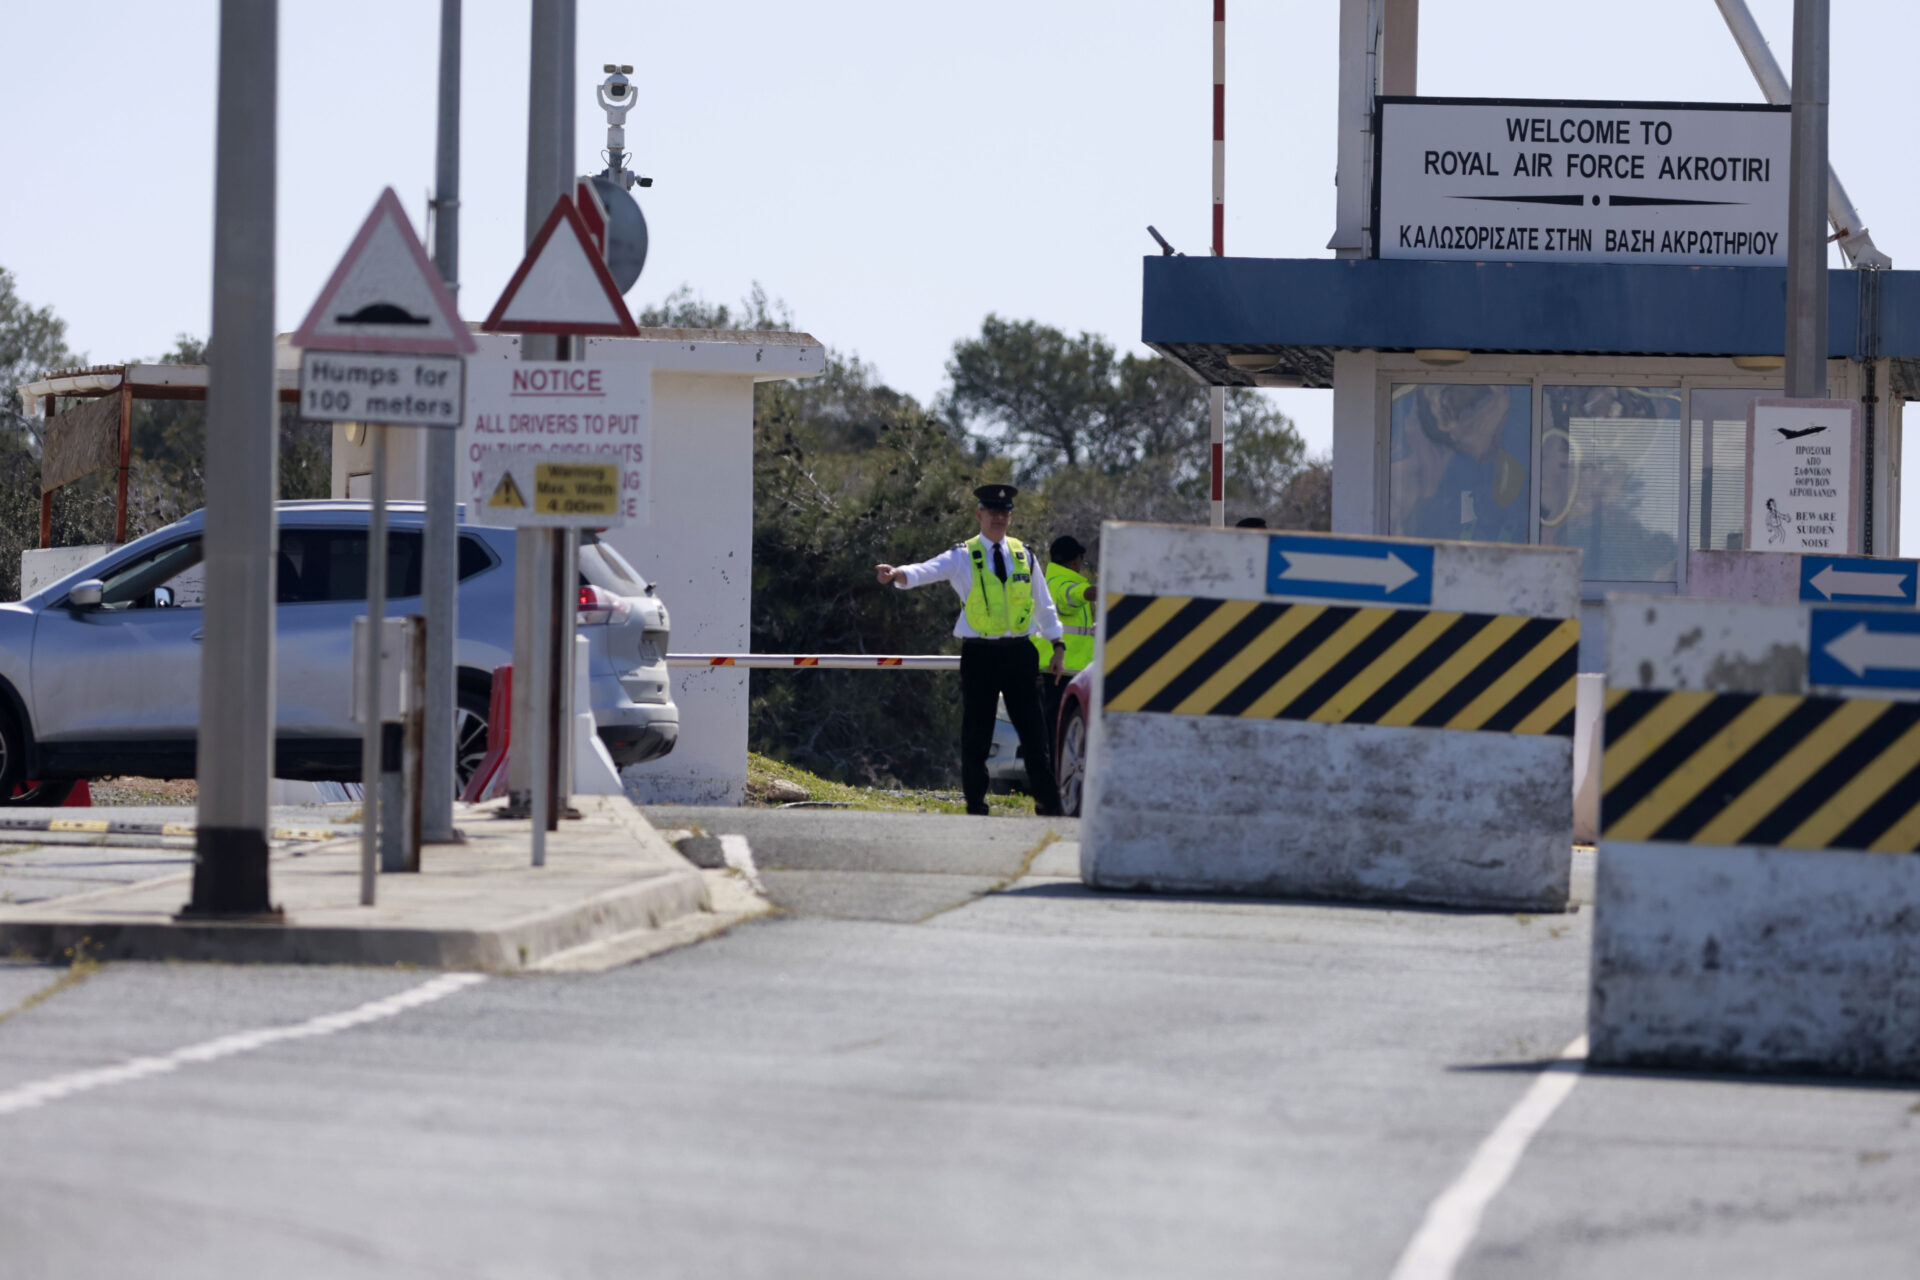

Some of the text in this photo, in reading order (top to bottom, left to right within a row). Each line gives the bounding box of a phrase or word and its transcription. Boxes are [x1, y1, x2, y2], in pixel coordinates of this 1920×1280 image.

[1506, 118, 1673, 146] WELCOME TO
[1424, 151, 1771, 182] ROYAL AIR FORCE AKROTIRI
[1399, 225, 1779, 256] ΚΑΛΩΣΟΡΙΣΑΤΕ ΣΤΗΝ ΒΑΣΗ ΑΚΡΩΤΗΡΙΟΥ
[311, 361, 448, 389] Humps for
[513, 369, 603, 393] NOTICE
[308, 390, 453, 415] 100 meters
[475, 414, 639, 435] ALL DRIVERS TO PUT
[1796, 511, 1837, 521] BEWARE
[1796, 525, 1834, 535] SUDDEN
[1801, 538, 1830, 548] NOISE
